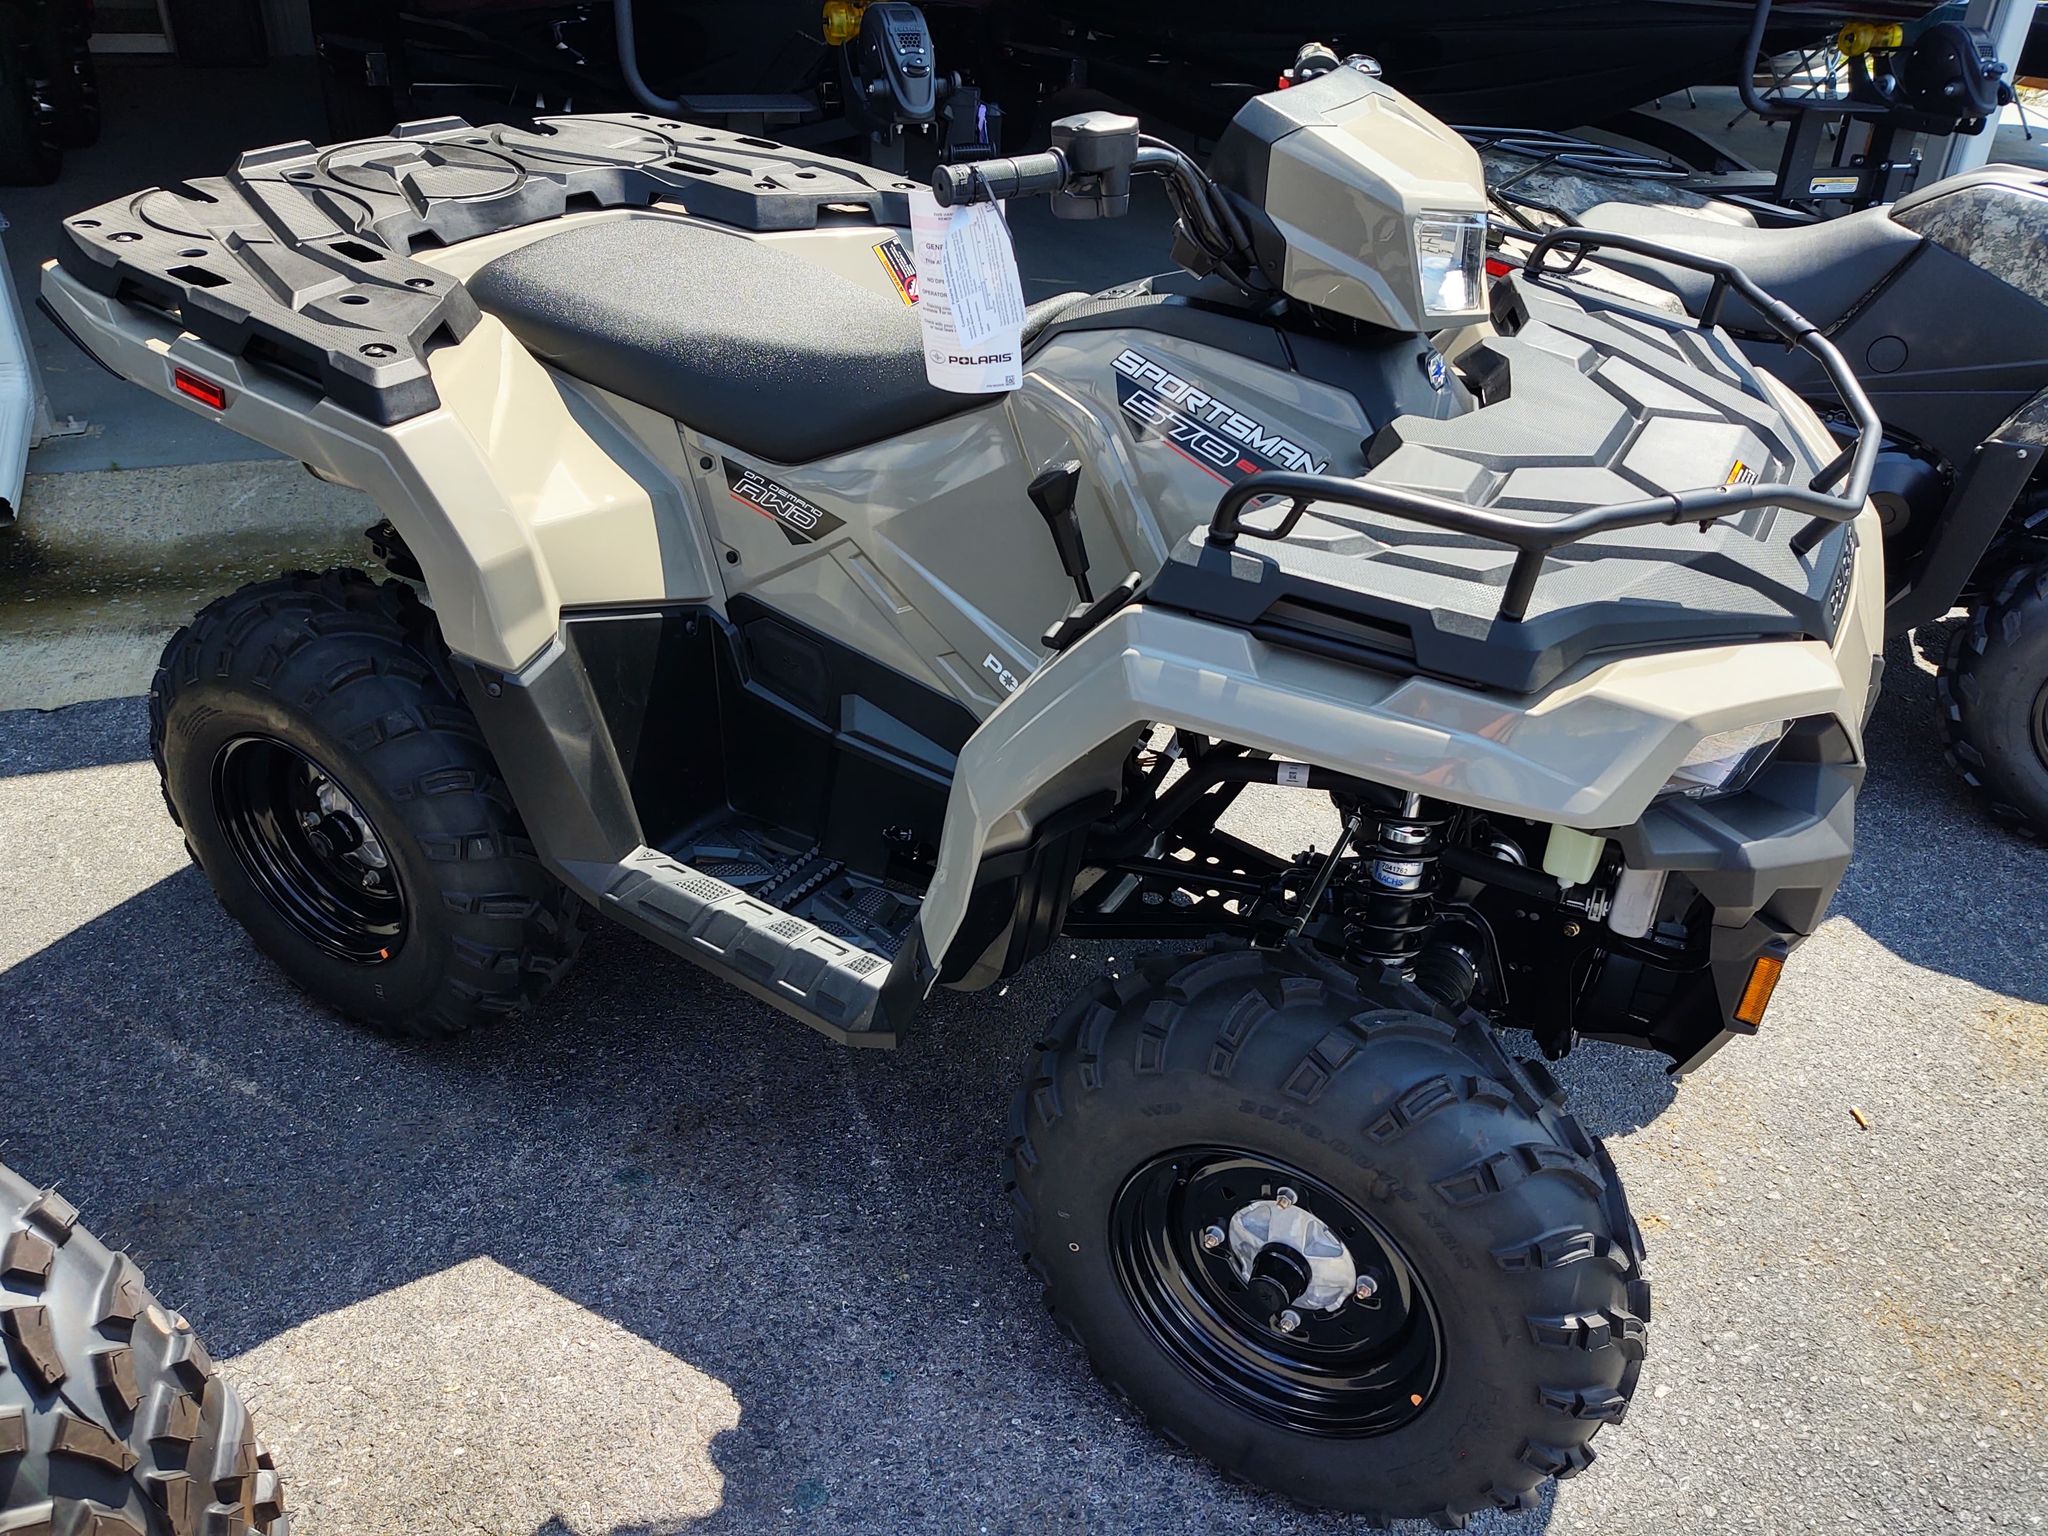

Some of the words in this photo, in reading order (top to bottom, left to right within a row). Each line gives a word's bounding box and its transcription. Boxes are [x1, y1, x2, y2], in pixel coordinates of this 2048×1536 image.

[949, 353, 1012, 365] POLARIS
[1111, 349, 1329, 475] SPORTSMAN
[1122, 389, 1240, 467] 570
[732, 478, 817, 530] AWD
[1377, 872, 1404, 887] SACHS
